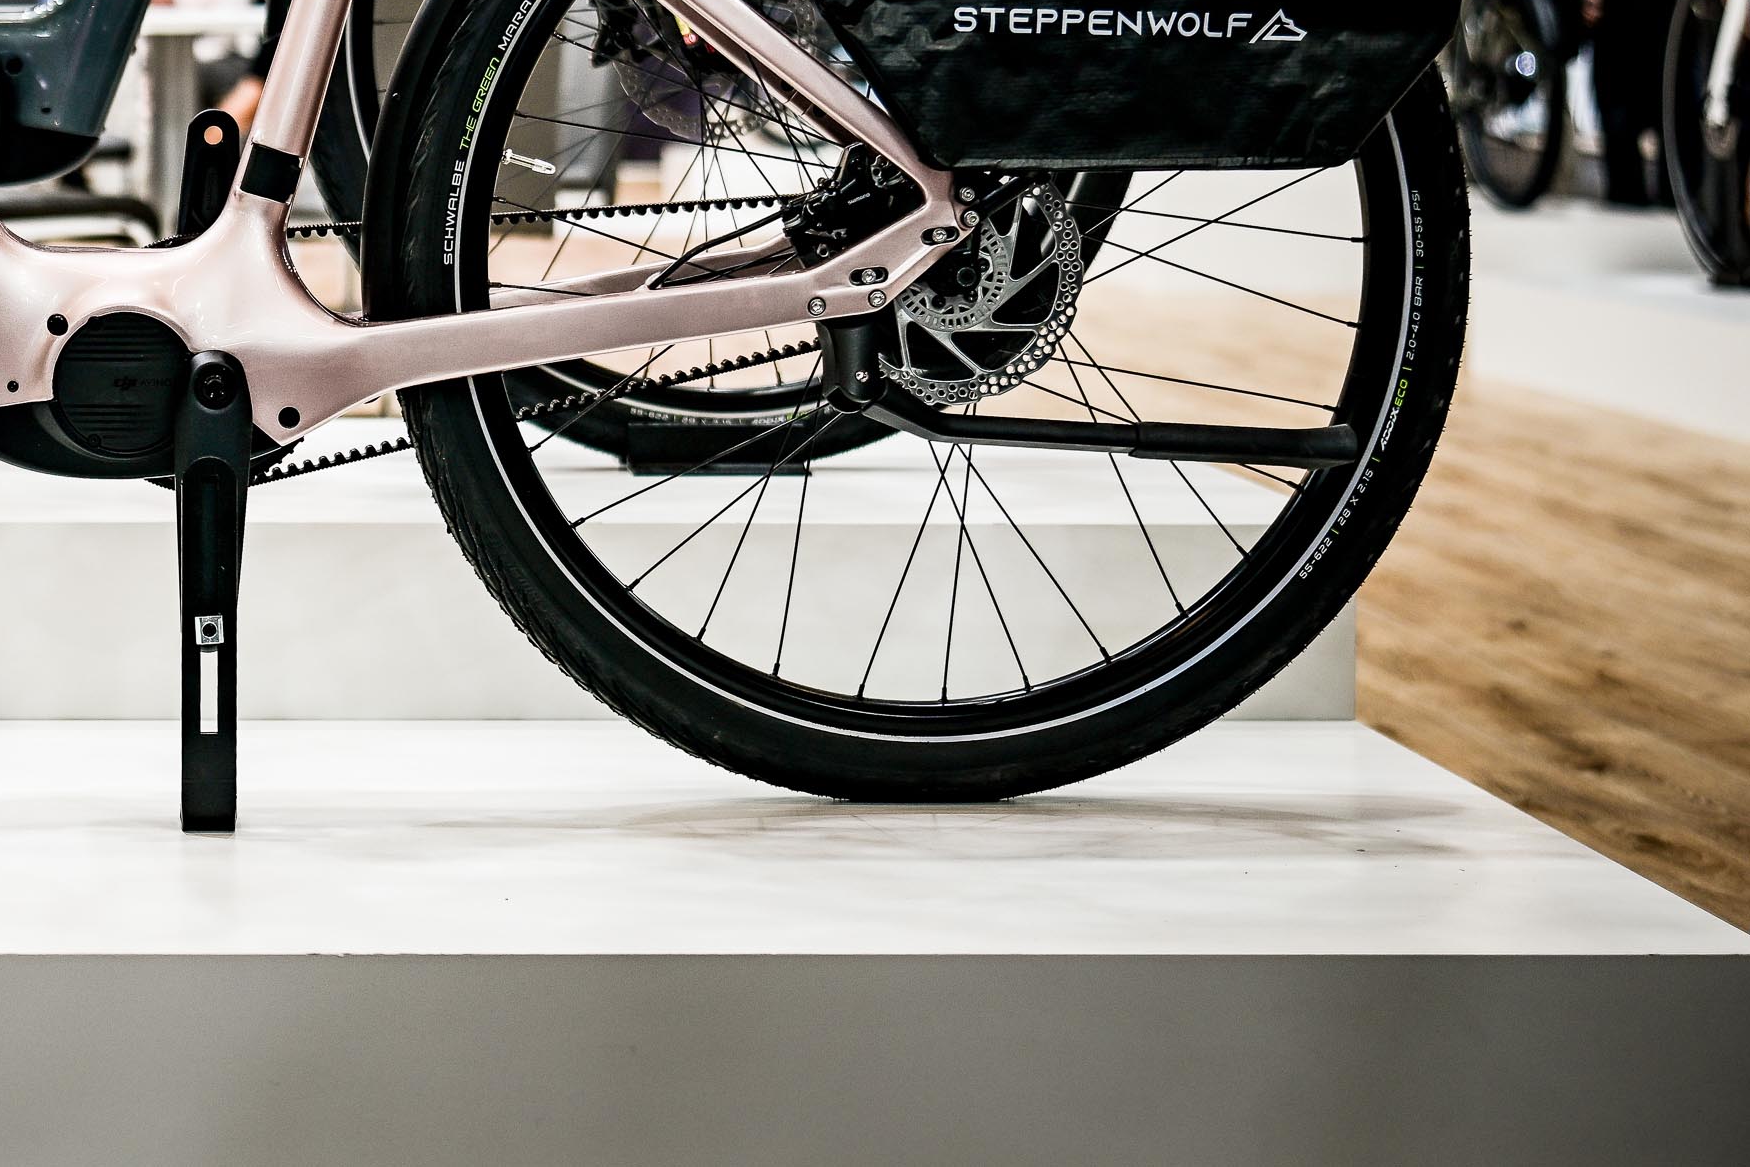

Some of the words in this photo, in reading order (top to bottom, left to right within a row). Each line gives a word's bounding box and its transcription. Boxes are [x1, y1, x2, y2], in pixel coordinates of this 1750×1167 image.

[953, 6, 1253, 38] STEPPENWOLF
[443, 160, 465, 265] SCHWALBE
[459, 115, 477, 150] THE
[472, 56, 500, 113] GREEN
[1411, 189, 1421, 211] PSI
[1414, 216, 1424, 258] 30-55
[1413, 276, 1424, 307] BAR
[1406, 311, 1421, 361] 2.0-4.0
[1359, 468, 1374, 494] 2.15
[1337, 508, 1351, 527] 28
[1298, 537, 1333, 579] 55-622
